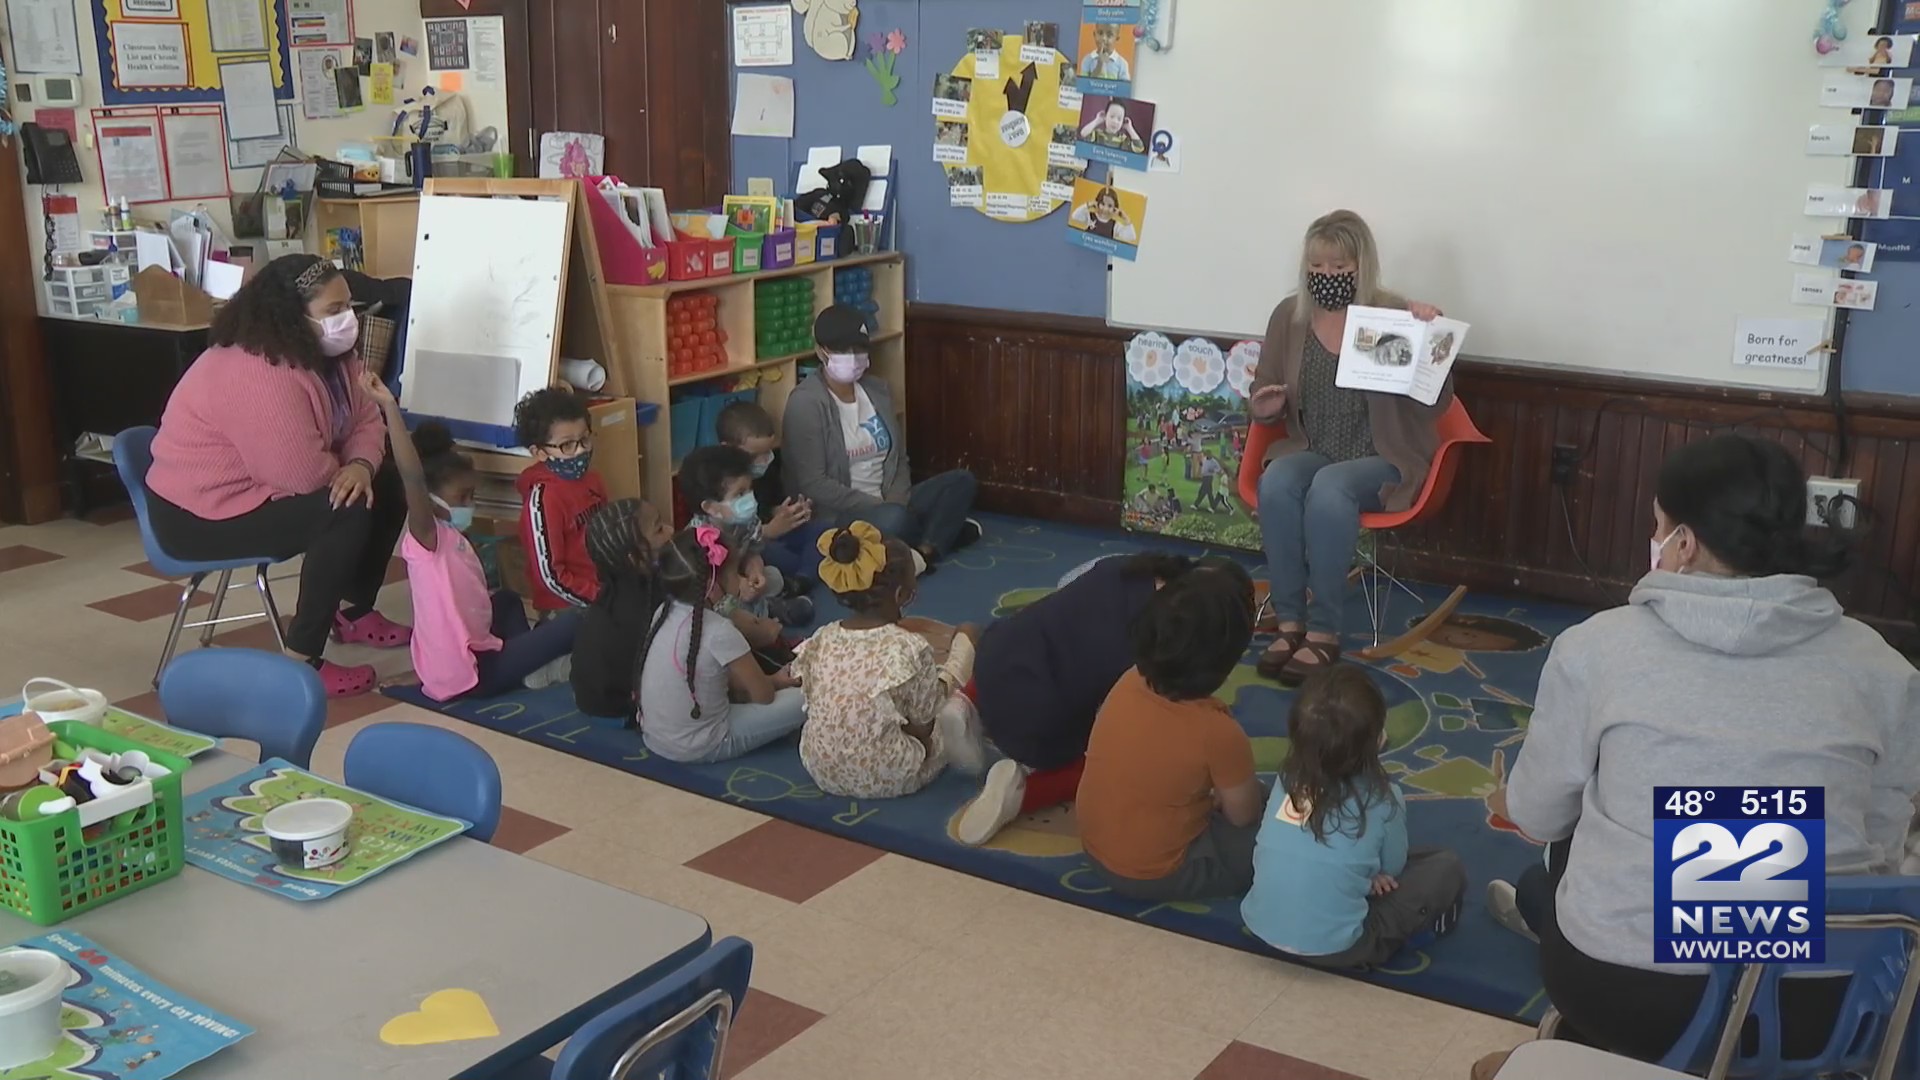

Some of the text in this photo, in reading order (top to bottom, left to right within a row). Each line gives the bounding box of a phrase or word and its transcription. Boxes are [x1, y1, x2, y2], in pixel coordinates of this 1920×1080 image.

[158, 44, 178, 52] Allergy
[1811, 134, 1830, 142] touch
[1793, 244, 1811, 252] smell
[1878, 244, 1911, 252] Months
[1801, 286, 1823, 294] senses
[1138, 337, 1168, 351] hearing
[1747, 333, 1798, 347] Born for
[1188, 344, 1214, 356] touch
[1745, 353, 1807, 365] greatness!
[214, 856, 260, 878] minutes
[282, 883, 320, 897] Spend
[46, 933, 82, 952] Spend
[98, 964, 144, 993] minutes
[140, 989, 174, 1010] every
[170, 1005, 193, 1020] day
[189, 1013, 241, 1039] MOVING!
